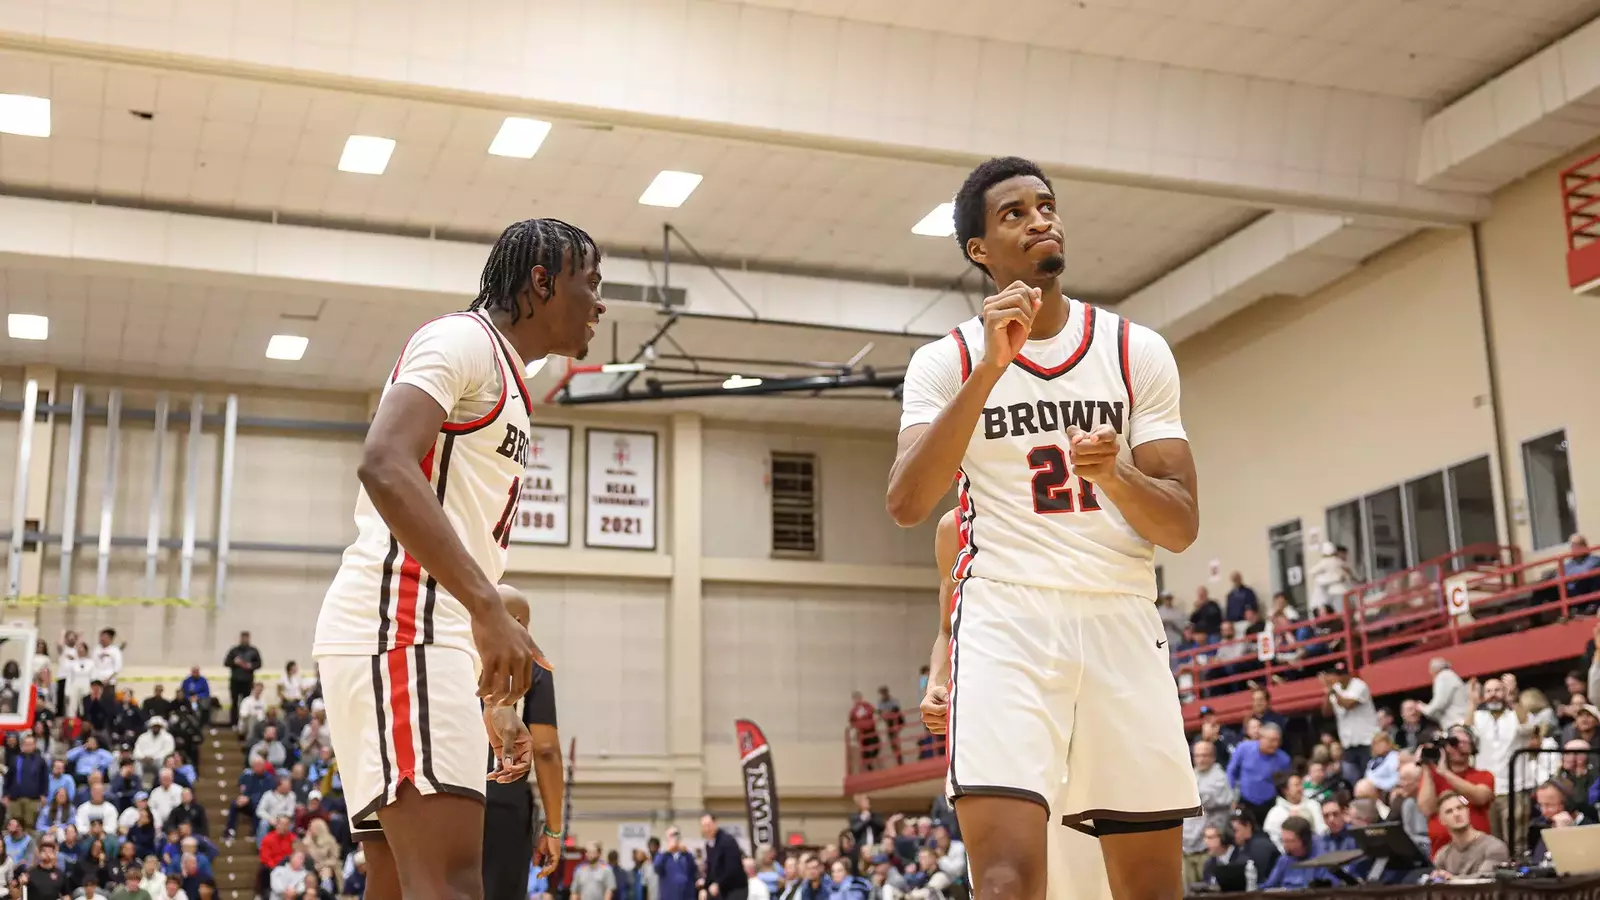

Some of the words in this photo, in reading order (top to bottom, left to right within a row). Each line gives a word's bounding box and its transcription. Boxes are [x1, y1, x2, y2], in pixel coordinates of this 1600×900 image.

[982, 400, 1124, 439] BROWN
[496, 423, 529, 469] BRO
[526, 477, 553, 491] CAA
[606, 483, 636, 495] NCAA
[601, 516, 641, 534] 2021
[1452, 588, 1464, 607] C
[747, 762, 774, 848] OWN
